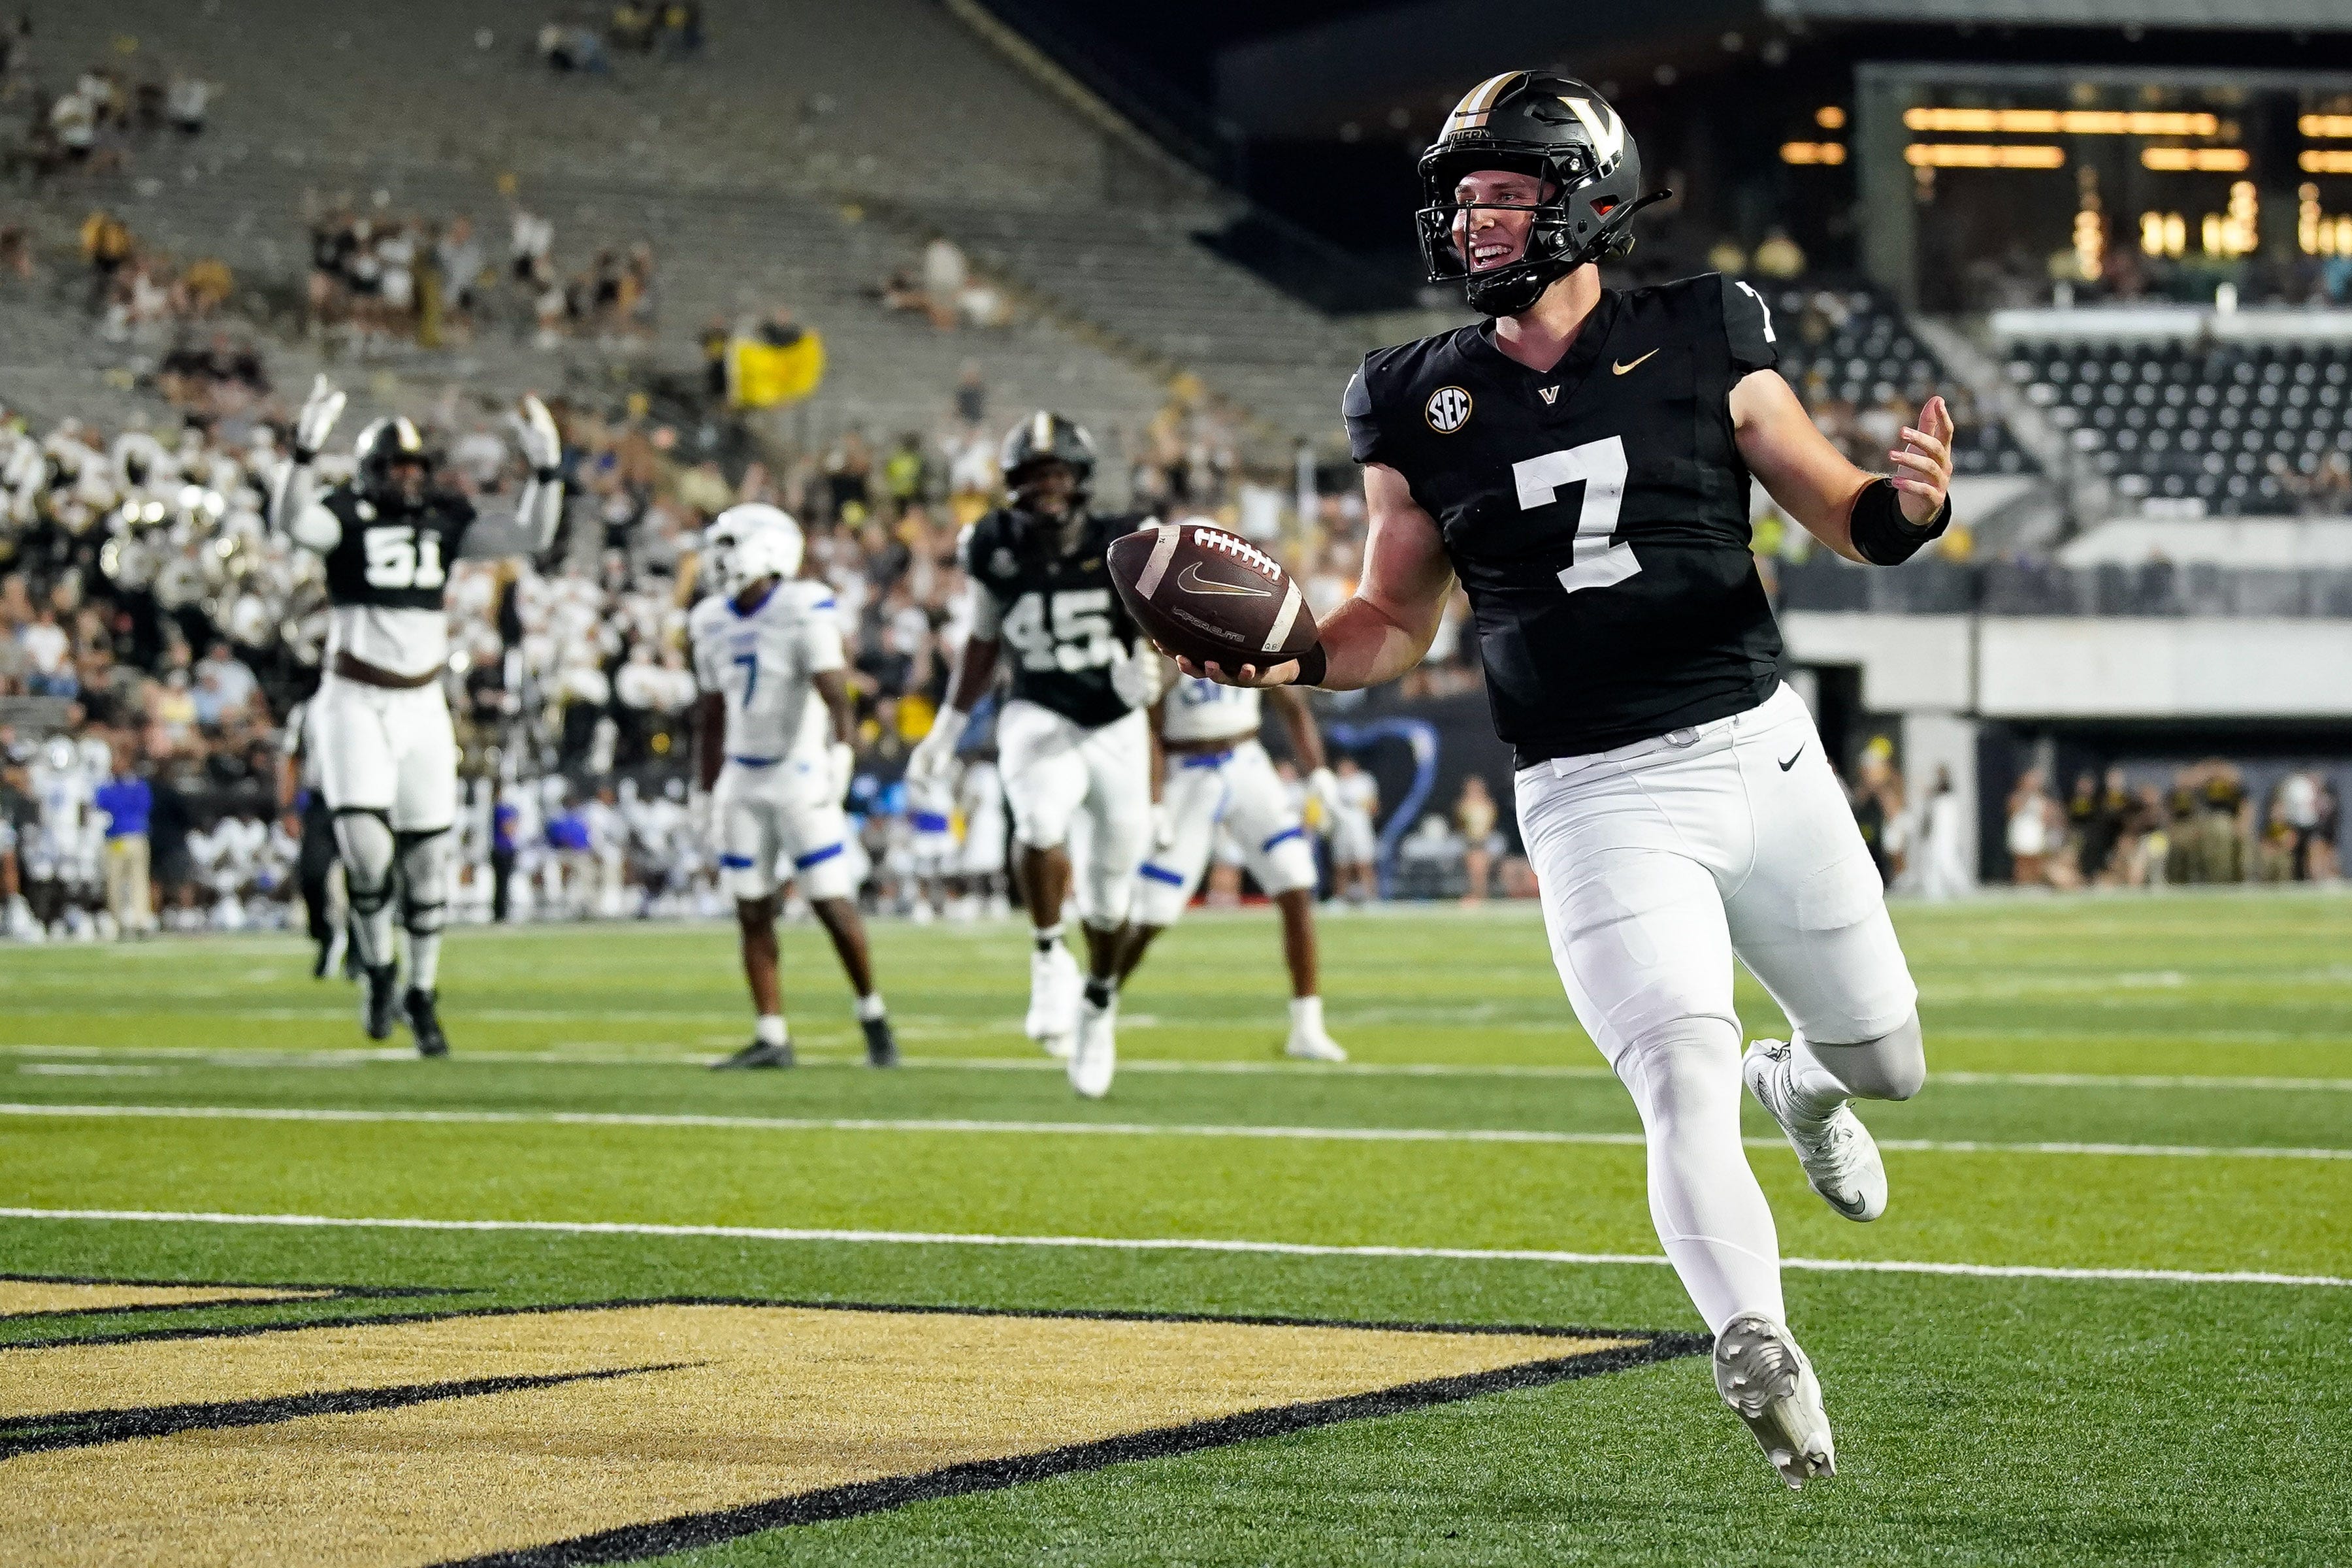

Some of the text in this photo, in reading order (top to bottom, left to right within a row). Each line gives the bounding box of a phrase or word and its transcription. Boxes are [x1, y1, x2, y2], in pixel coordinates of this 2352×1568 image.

[1735, 281, 1776, 344] 7
[1429, 388, 1469, 431] SEC
[1538, 385, 1560, 405] V
[1512, 434, 1642, 594] 7
[363, 525, 446, 590] 51
[1001, 587, 1113, 672] 45
[732, 652, 759, 710] 7
